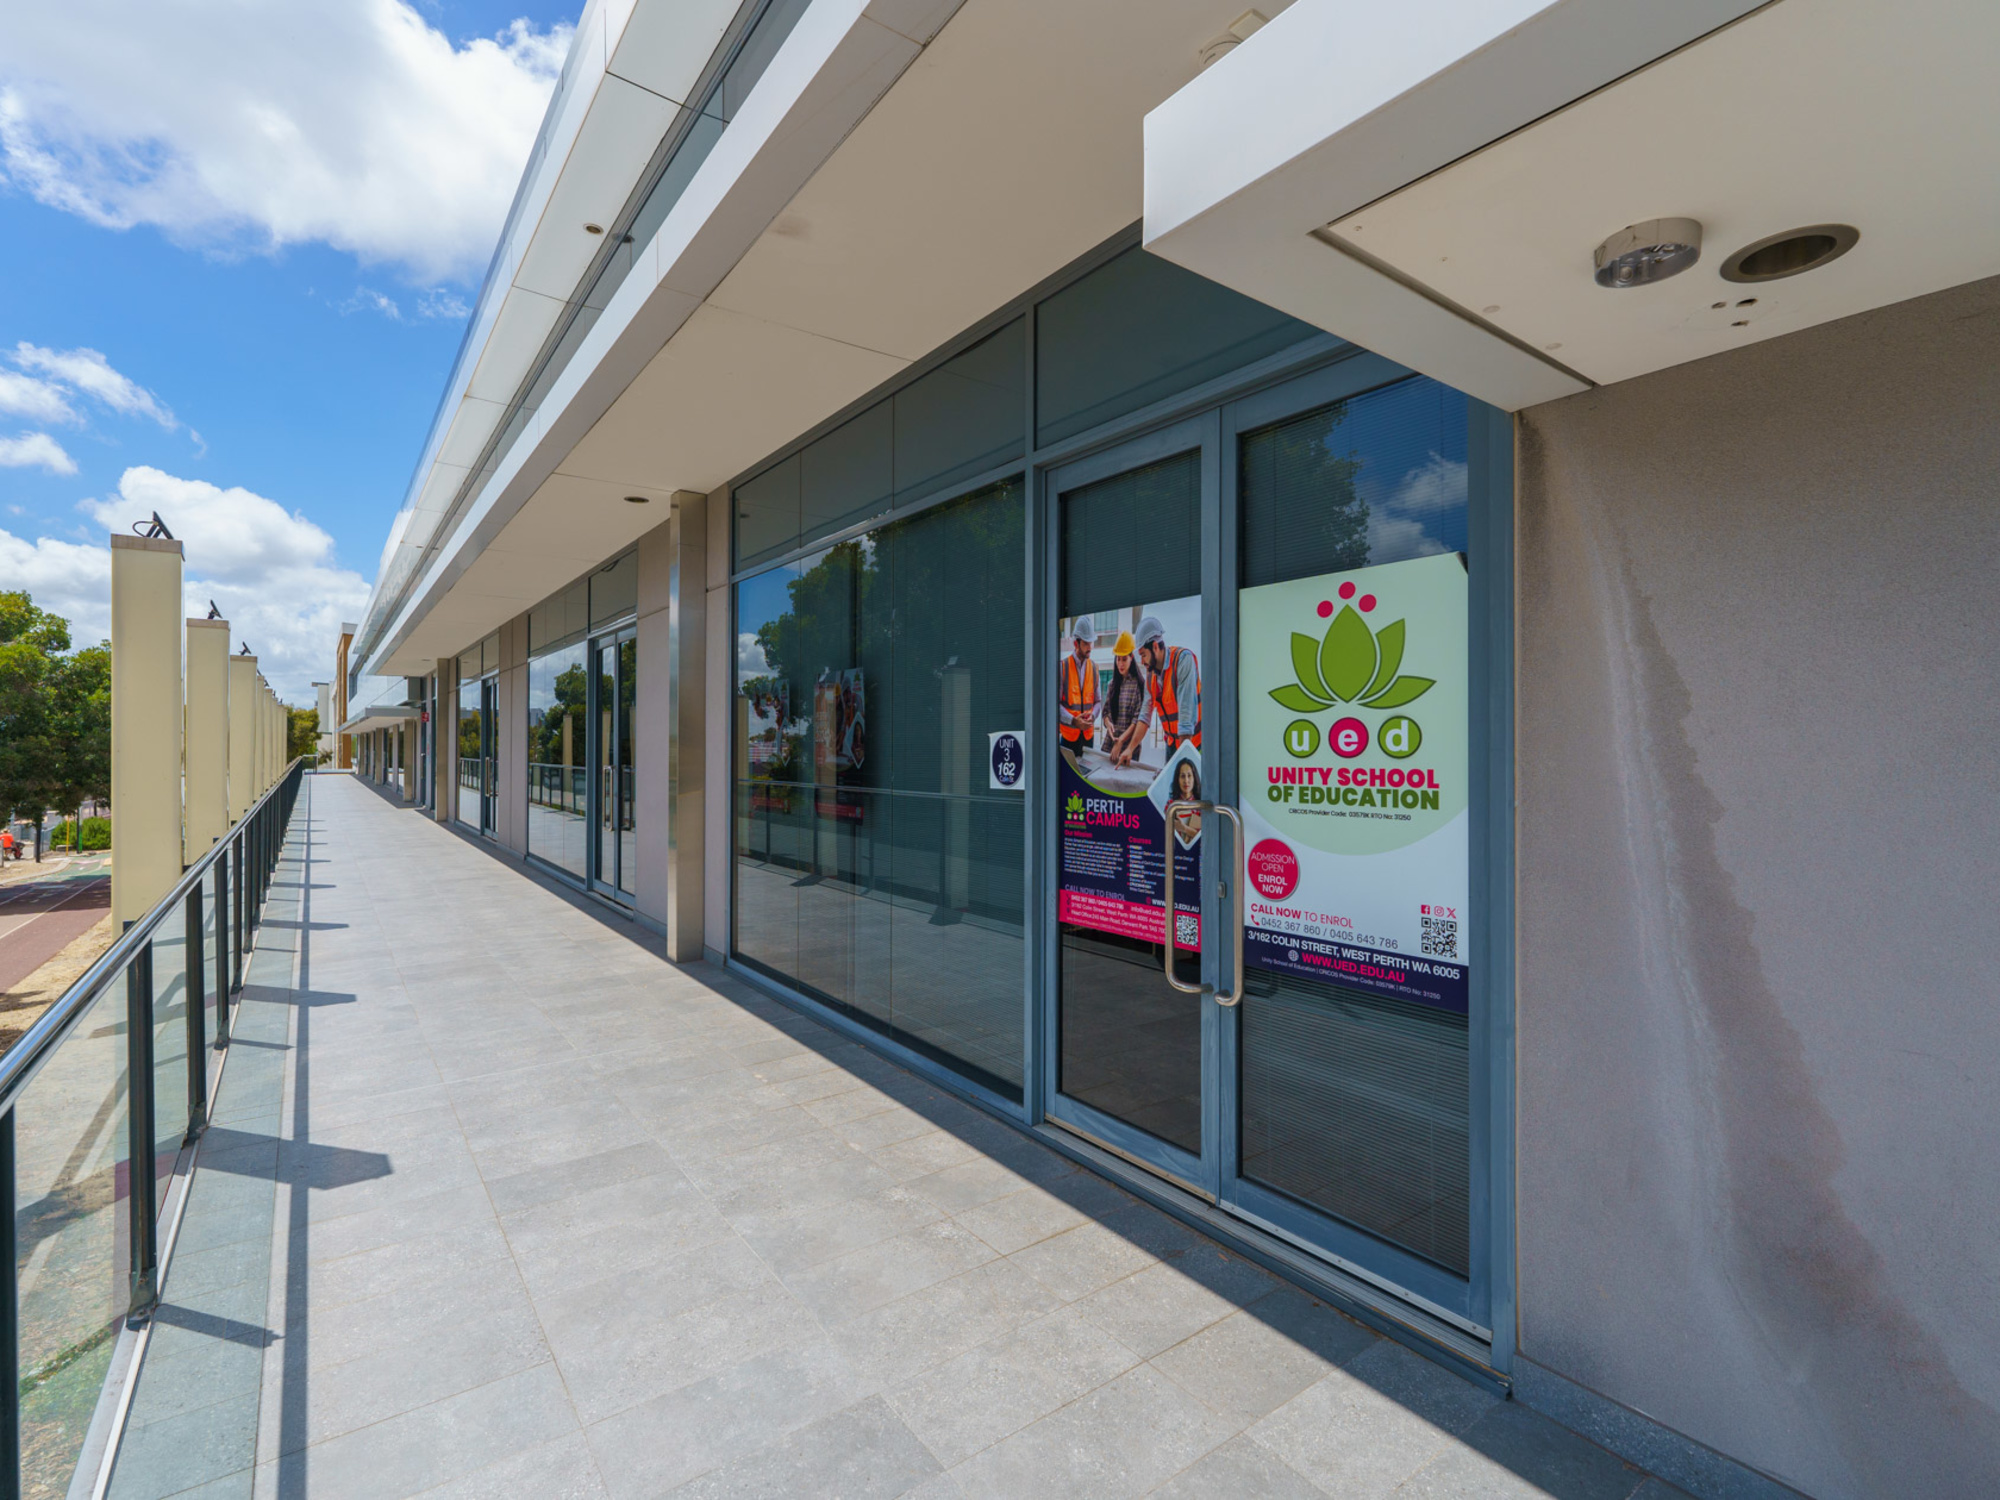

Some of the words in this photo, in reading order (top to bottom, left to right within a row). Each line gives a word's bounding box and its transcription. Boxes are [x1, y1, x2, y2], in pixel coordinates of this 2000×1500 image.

[999, 739, 1014, 749] UNIT
[1004, 748, 1010, 762] 3
[998, 762, 1016, 776] 162
[1267, 767, 1333, 786] UNITY
[1337, 768, 1440, 789] SCHOOL
[1267, 785, 1294, 803] OF
[1299, 786, 1440, 810] EDUCATION
[1086, 798, 1124, 815] PERTH
[1331, 810, 1347, 818] Code:
[1086, 811, 1140, 829] CAMPUS
[1251, 852, 1295, 865] ADMISSION
[1261, 862, 1284, 873] OPEN
[1258, 873, 1288, 886] ENROL
[1065, 884, 1081, 893] CALL
[1080, 887, 1095, 896] NOW
[1106, 891, 1126, 901] ENROL
[1262, 884, 1283, 895] NOW
[1251, 903, 1274, 915] CALL
[1276, 906, 1302, 919] NOW
[1304, 911, 1318, 922] TO
[1320, 914, 1353, 928] ENROL
[1261, 917, 1282, 929] 0452
[1284, 921, 1301, 932] 367
[1303, 924, 1321, 936] 860
[1330, 928, 1354, 941] 0405
[1356, 933, 1376, 946] 643
[1378, 937, 1399, 950] 786
[1248, 930, 1270, 943] 3/162
[1271, 935, 1300, 949] COLIN
[1301, 941, 1340, 958] STREET,
[1341, 947, 1371, 963] WEST
[1373, 954, 1410, 971] PERTH
[1411, 960, 1432, 975] WA
[1432, 965, 1461, 980] 6005
[1301, 952, 1405, 983] WWW.UED.EDU.AU
